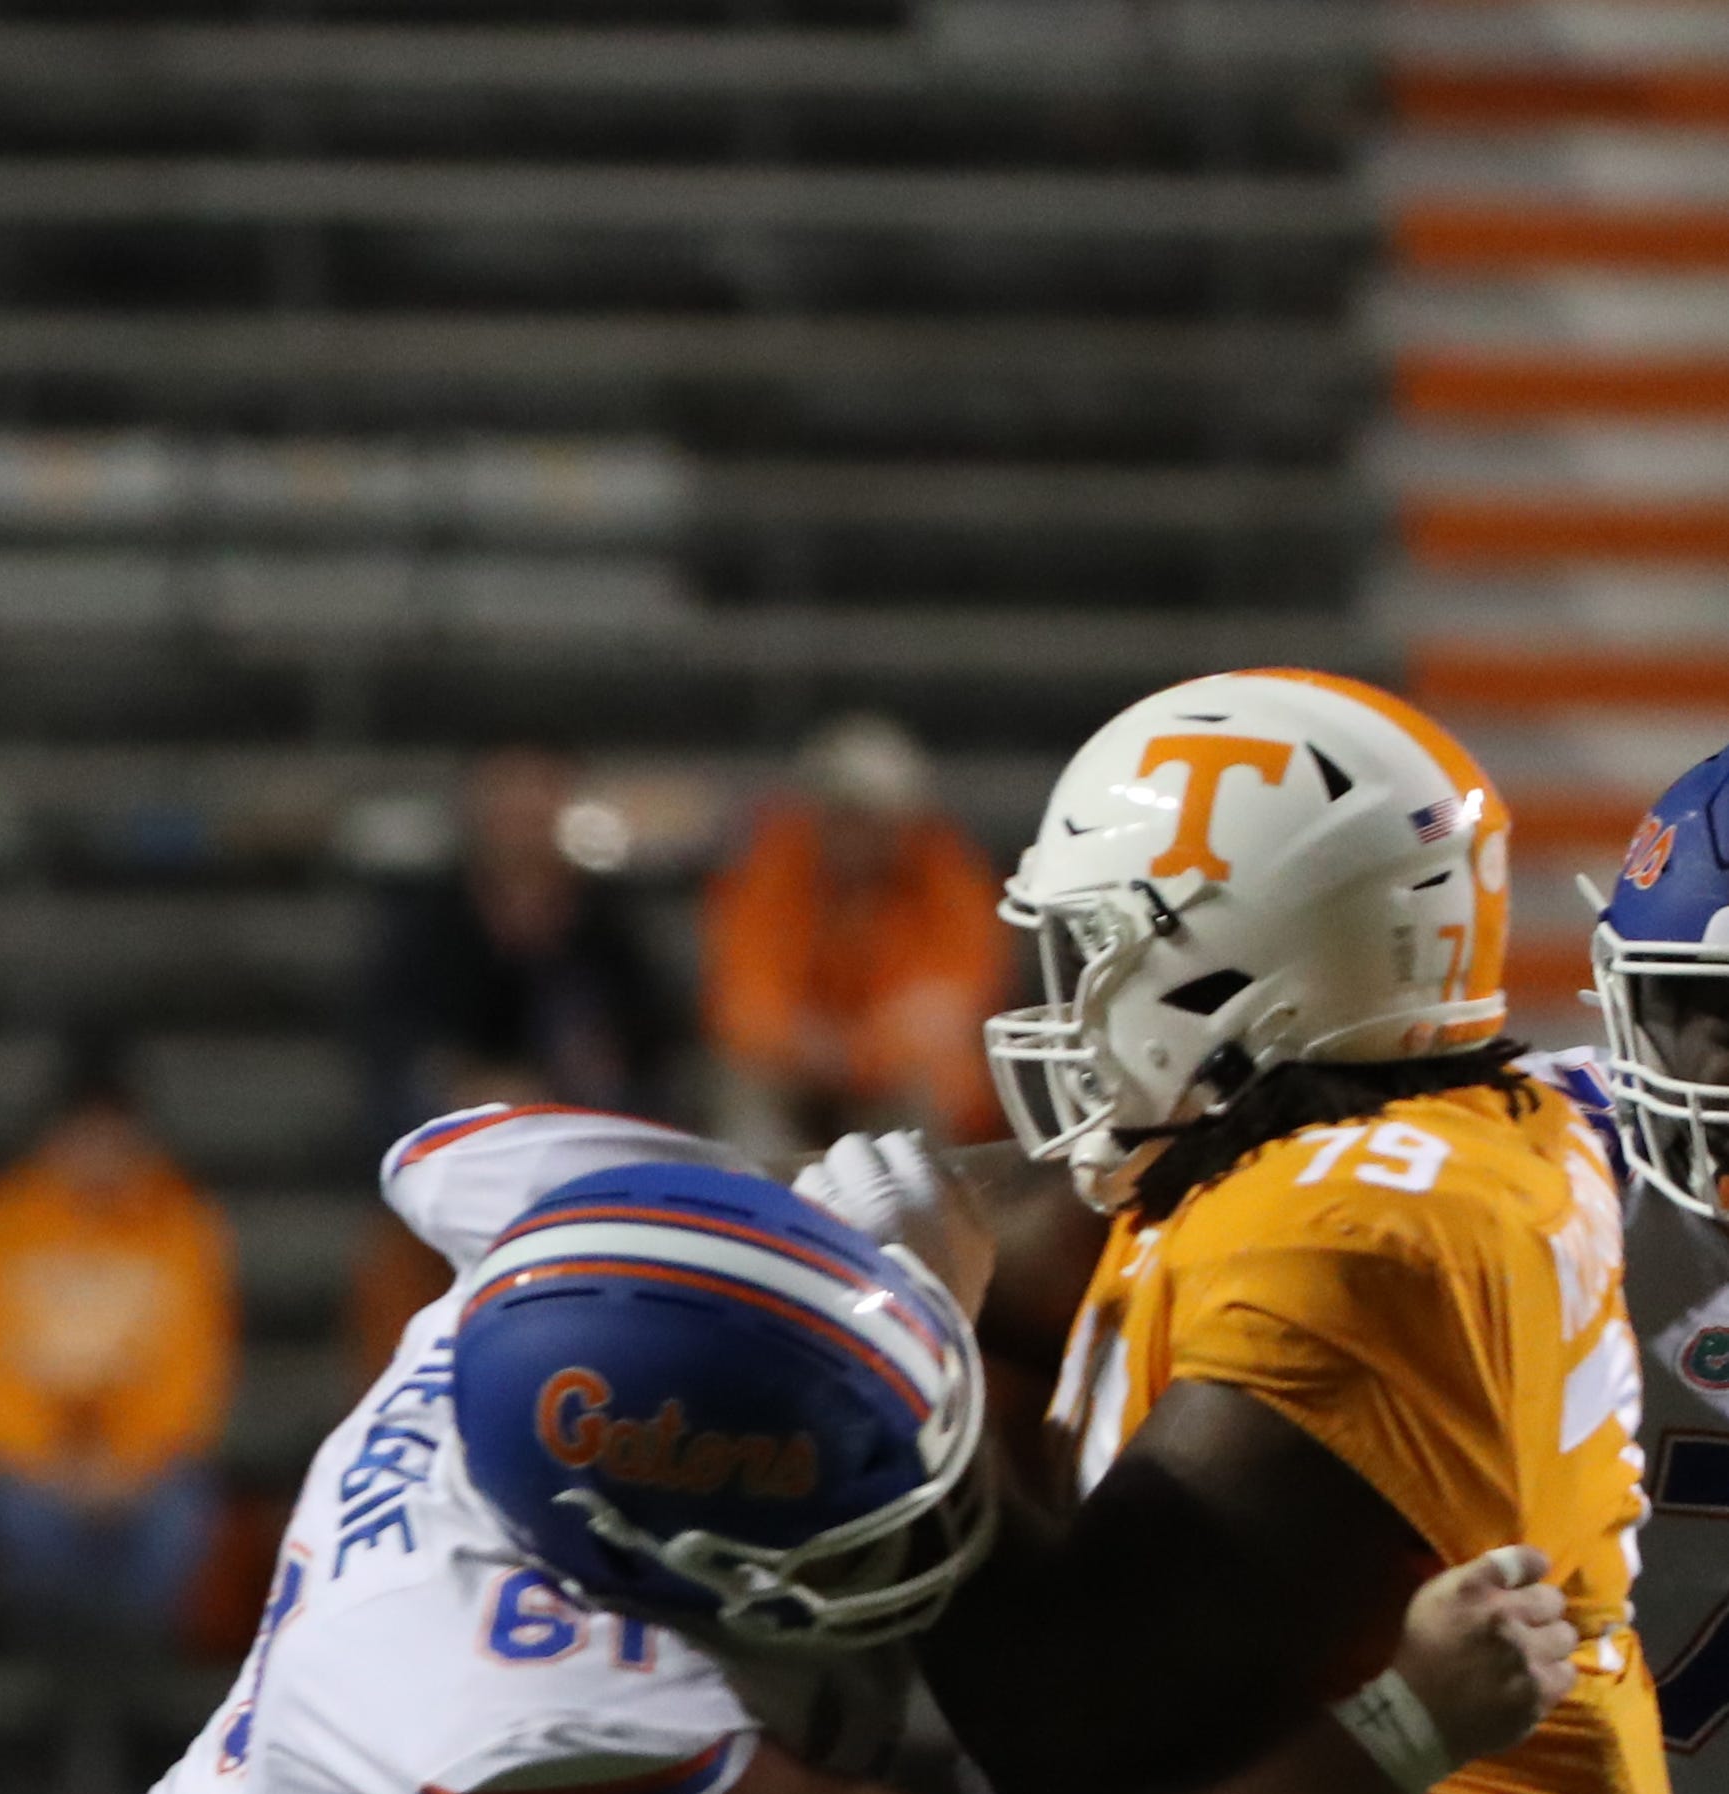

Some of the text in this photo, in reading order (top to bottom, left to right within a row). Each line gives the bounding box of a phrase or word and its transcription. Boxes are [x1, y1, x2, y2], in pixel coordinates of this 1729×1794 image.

[1135, 733, 1294, 881] T
[1294, 1121, 1450, 1193] 79
[533, 1366, 820, 1500] Gators
[479, 1566, 660, 1673] 61
